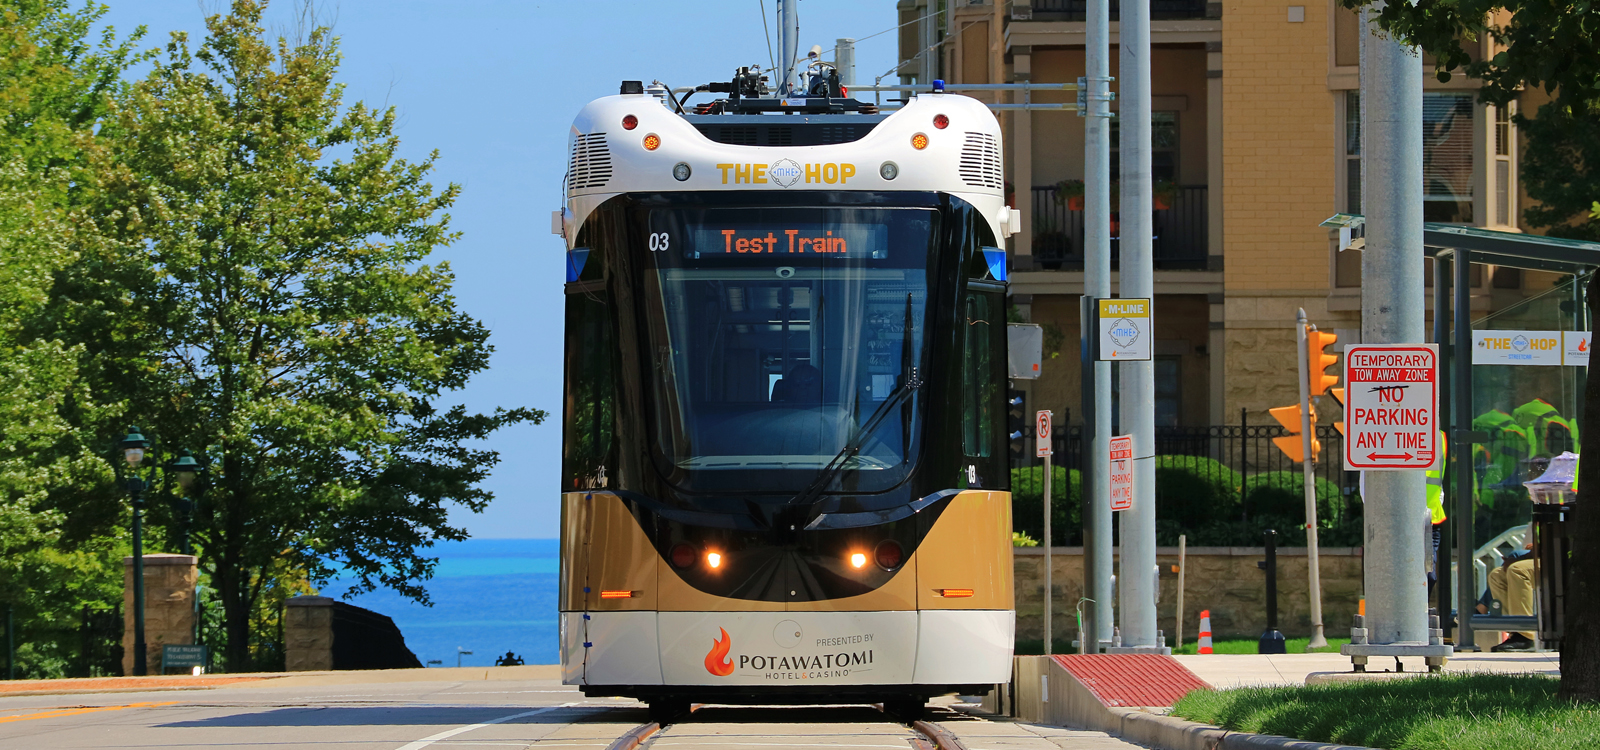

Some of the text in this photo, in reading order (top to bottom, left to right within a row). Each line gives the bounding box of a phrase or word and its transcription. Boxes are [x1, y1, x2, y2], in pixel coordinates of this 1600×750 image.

[716, 163, 856, 184] THE MKE HOP
[649, 232, 669, 251] 03
[721, 229, 847, 253] Test Train
[1115, 328, 1133, 337] MKE
[1483, 337, 1511, 350] THE
[1530, 338, 1557, 351] HOP
[1354, 354, 1429, 367] TEMPORARY
[1355, 369, 1429, 381] TOW AWAY ZONE
[1378, 385, 1404, 403] NO
[1354, 408, 1428, 425] PARKING
[1111, 441, 1130, 450] TEMPORARY
[1356, 431, 1427, 449] ANY TIME
[1117, 460, 1125, 471] NO
[968, 464, 976, 484] 03
[1112, 473, 1131, 484] PARKING
[816, 633, 874, 647] PRESENTED BY
[739, 649, 873, 670] POTAWATOMI
